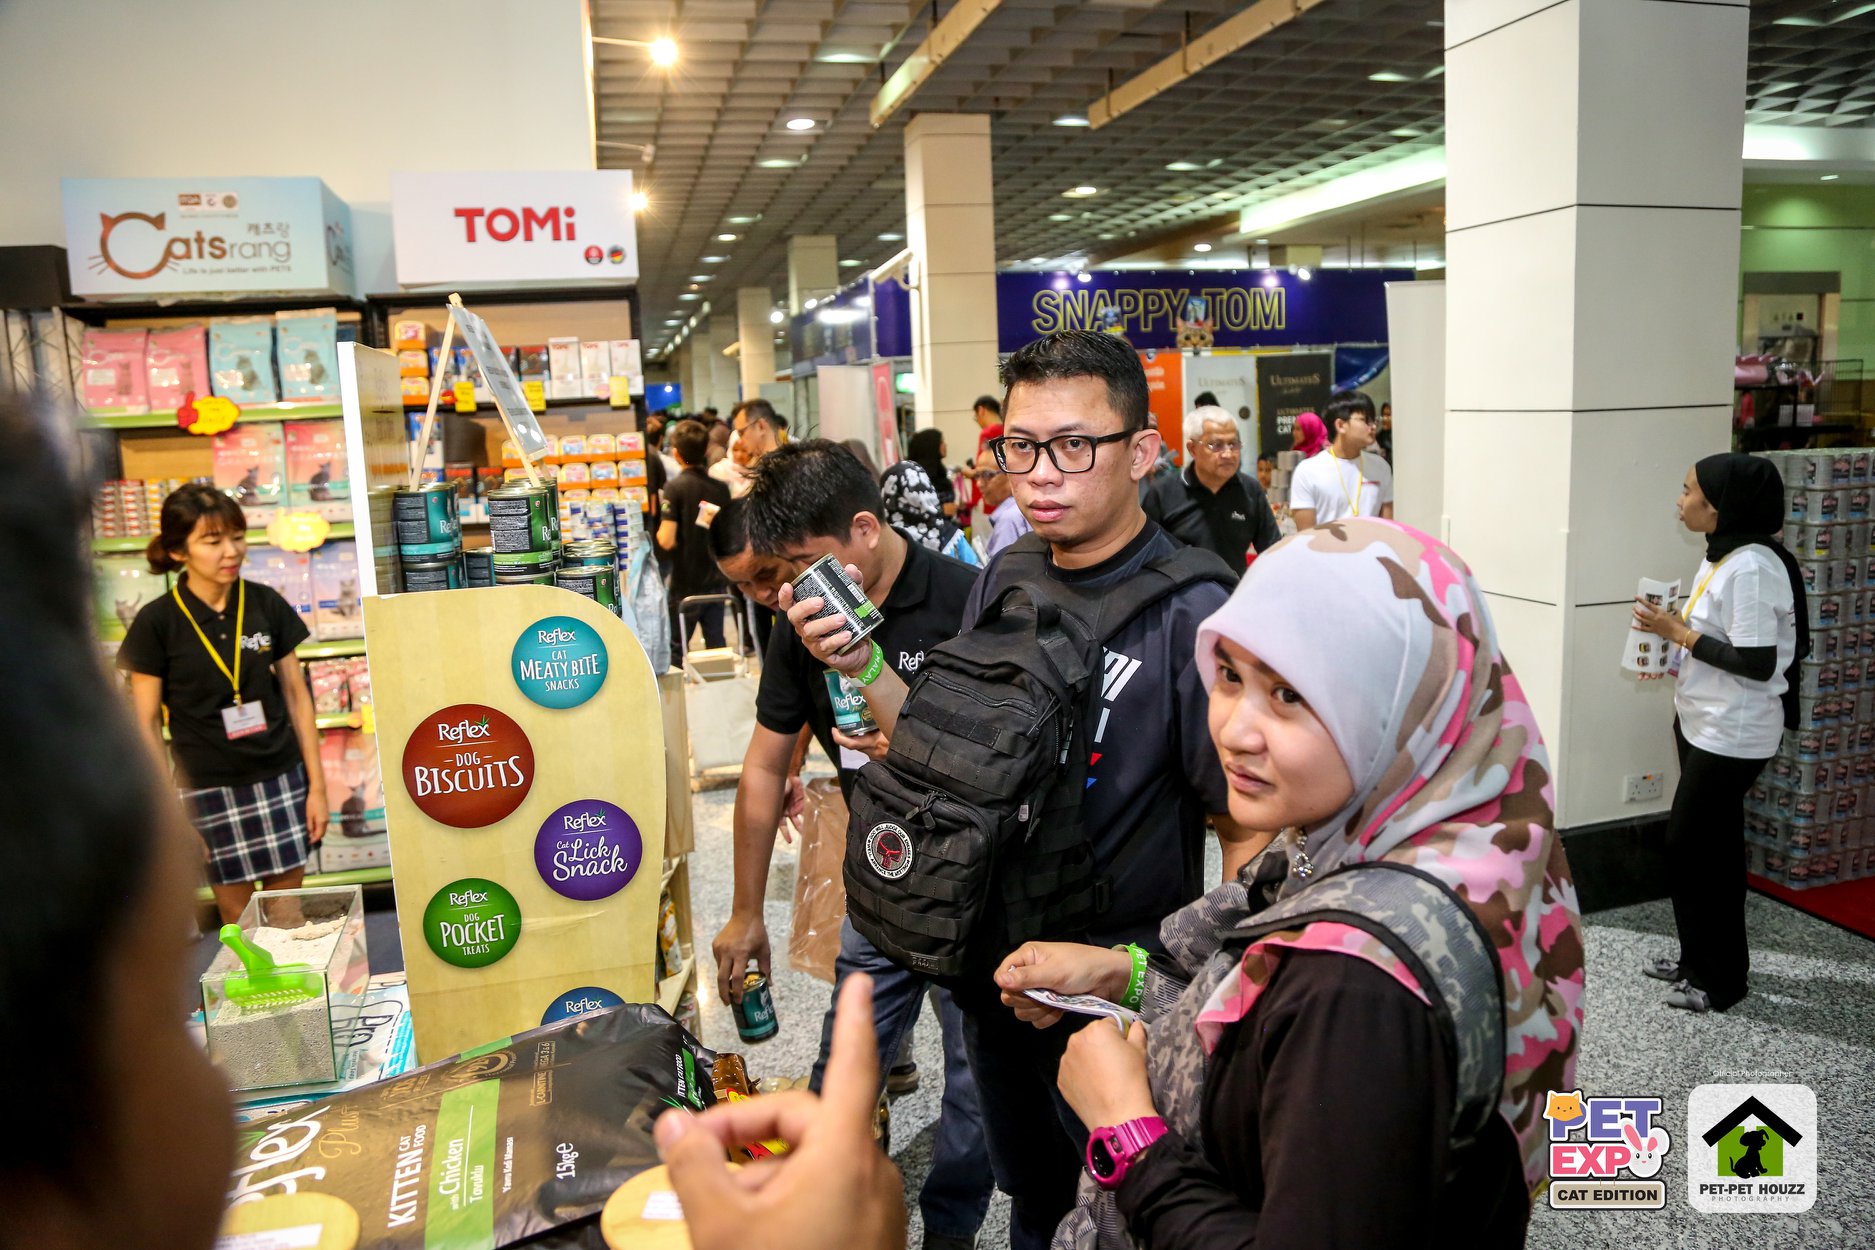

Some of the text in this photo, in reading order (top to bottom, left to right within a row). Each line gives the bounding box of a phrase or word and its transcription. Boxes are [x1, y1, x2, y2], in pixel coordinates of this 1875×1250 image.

[454, 206, 576, 242] TOMi
[1032, 287, 1286, 334] SNAPPY TOM
[538, 627, 576, 644] Reflex
[520, 653, 600, 681] MEATY BITE
[551, 650, 567, 661] CAT
[545, 678, 580, 692] SNACKS
[834, 692, 867, 711] Reflex
[437, 719, 490, 744] Reflex
[455, 751, 481, 767] DOG
[414, 755, 525, 797] BISCUITS
[563, 811, 606, 831] Reflex
[556, 835, 612, 862] Cat Lick
[552, 844, 628, 881] Snack
[449, 889, 488, 908] Reflex
[439, 914, 505, 948] POCKET
[463, 913, 480, 923] DOG
[462, 943, 490, 956] TREATS
[1130, 948, 1148, 1003] PET EXPO
[565, 997, 602, 1014] Reflex
[677, 1079, 686, 1098] ITTEN
[318, 1104, 362, 1159] Plus
[399, 1135, 412, 1152] CAT
[414, 1124, 427, 1151] FOOD
[438, 1138, 464, 1196] Chicken
[388, 1149, 423, 1229] KITTEN
[469, 1165, 484, 1204] Tavuklu
